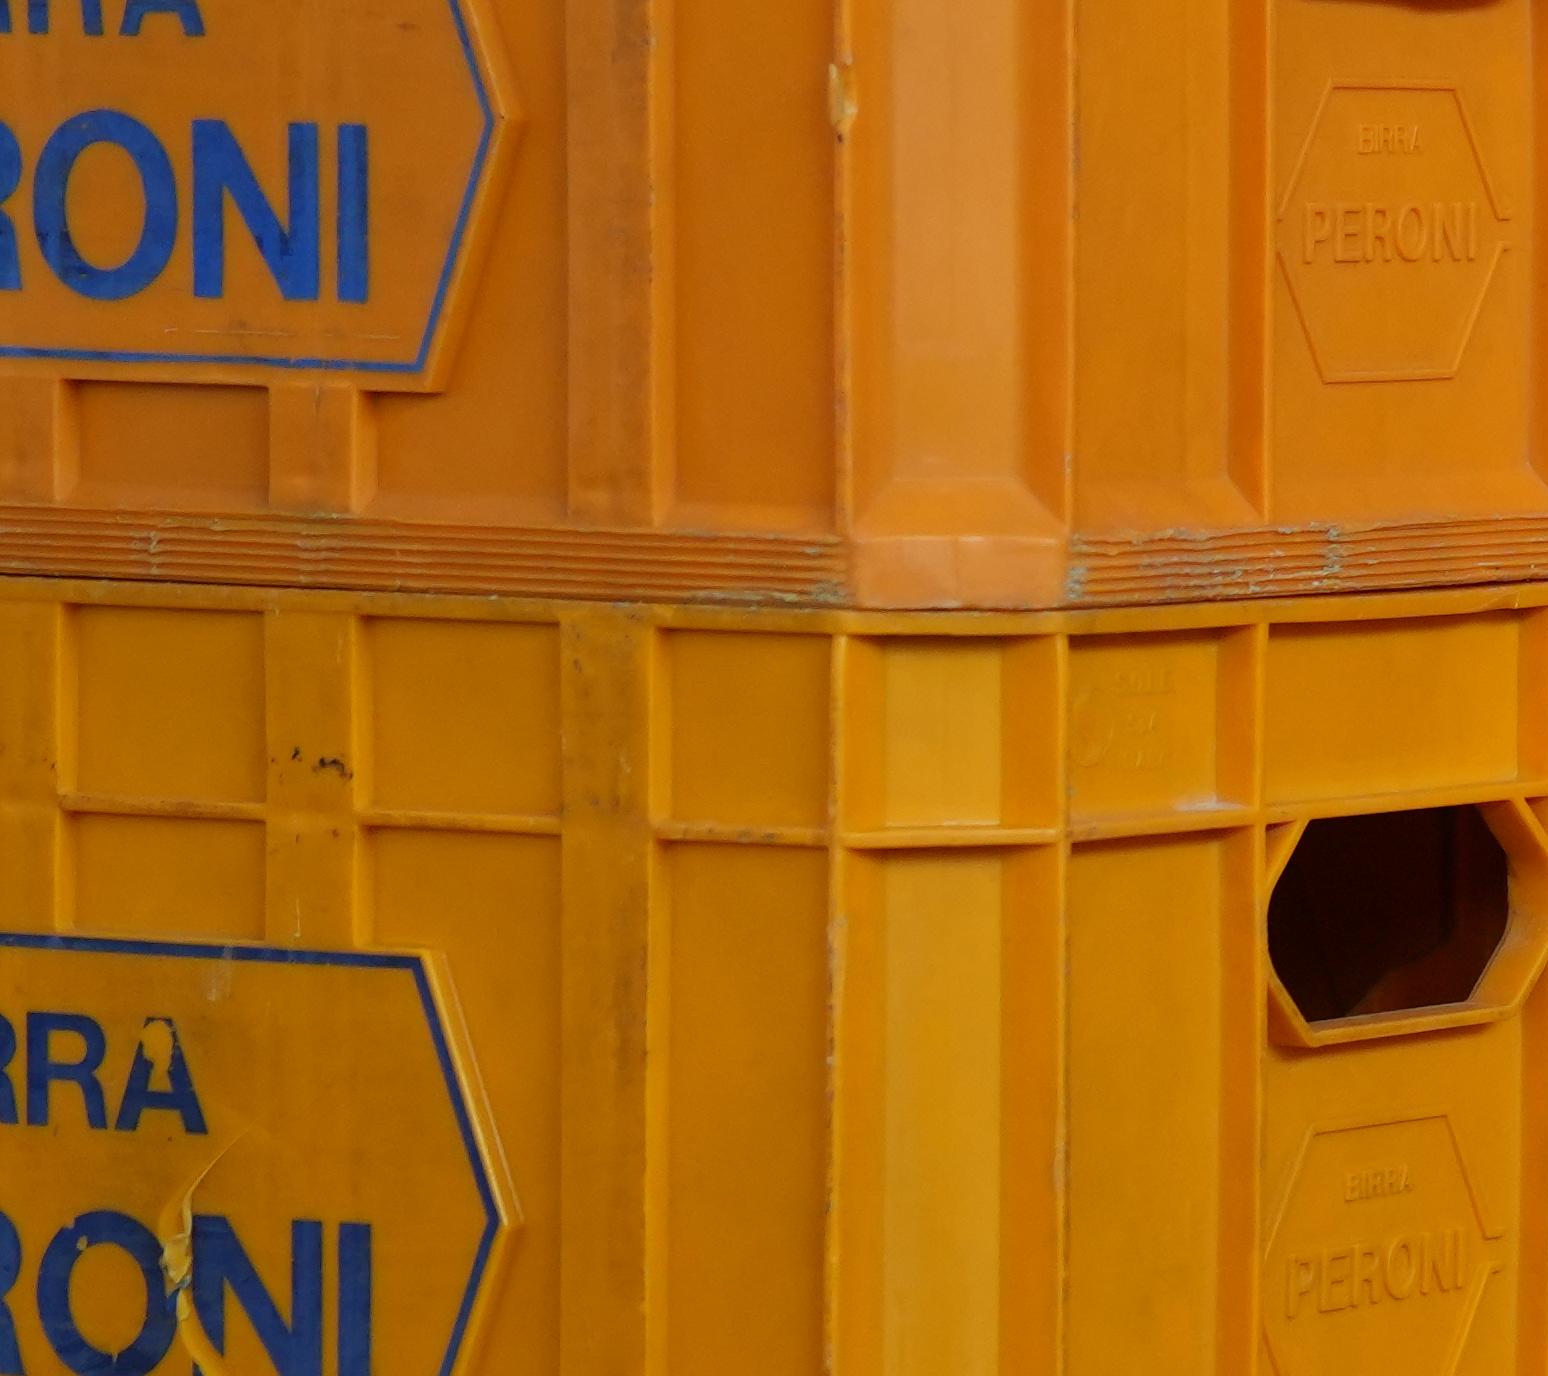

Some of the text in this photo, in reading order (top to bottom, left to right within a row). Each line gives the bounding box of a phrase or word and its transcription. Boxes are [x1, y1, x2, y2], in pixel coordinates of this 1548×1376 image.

[0, 107, 369, 303] ONI
[1302, 200, 1478, 265] PERONI
[0, 1010, 208, 1136] RA
[1284, 1225, 1467, 1320] PERONI
